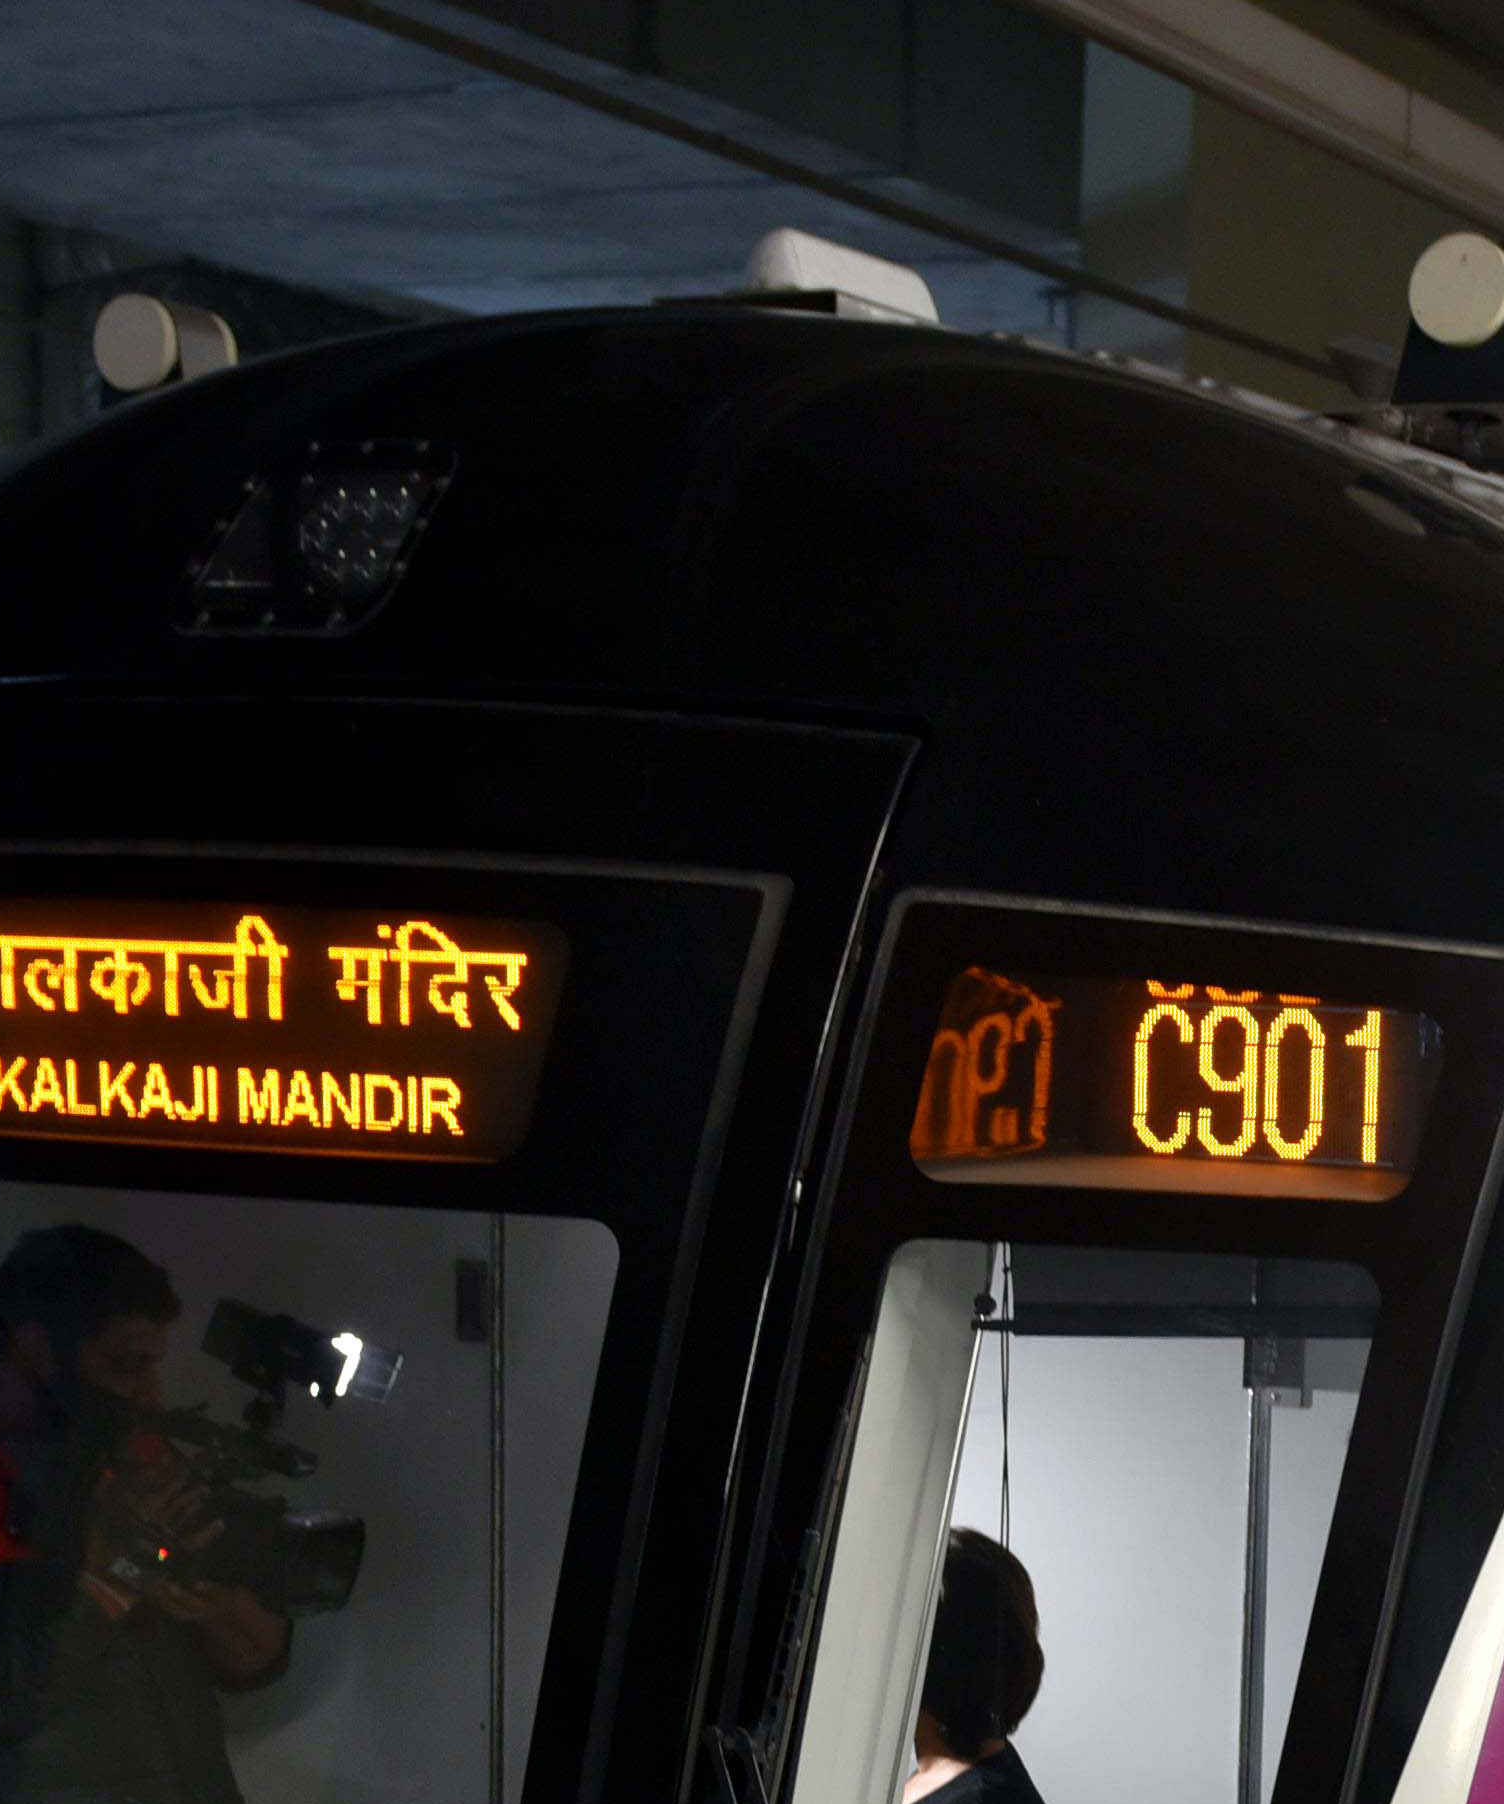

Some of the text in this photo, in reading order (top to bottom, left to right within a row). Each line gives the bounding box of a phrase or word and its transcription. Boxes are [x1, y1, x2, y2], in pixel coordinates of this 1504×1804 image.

[327, 920, 528, 1031] मंदिर
[236, 1066, 465, 1137] MANDIR
[1132, 1003, 1382, 1164] C901
